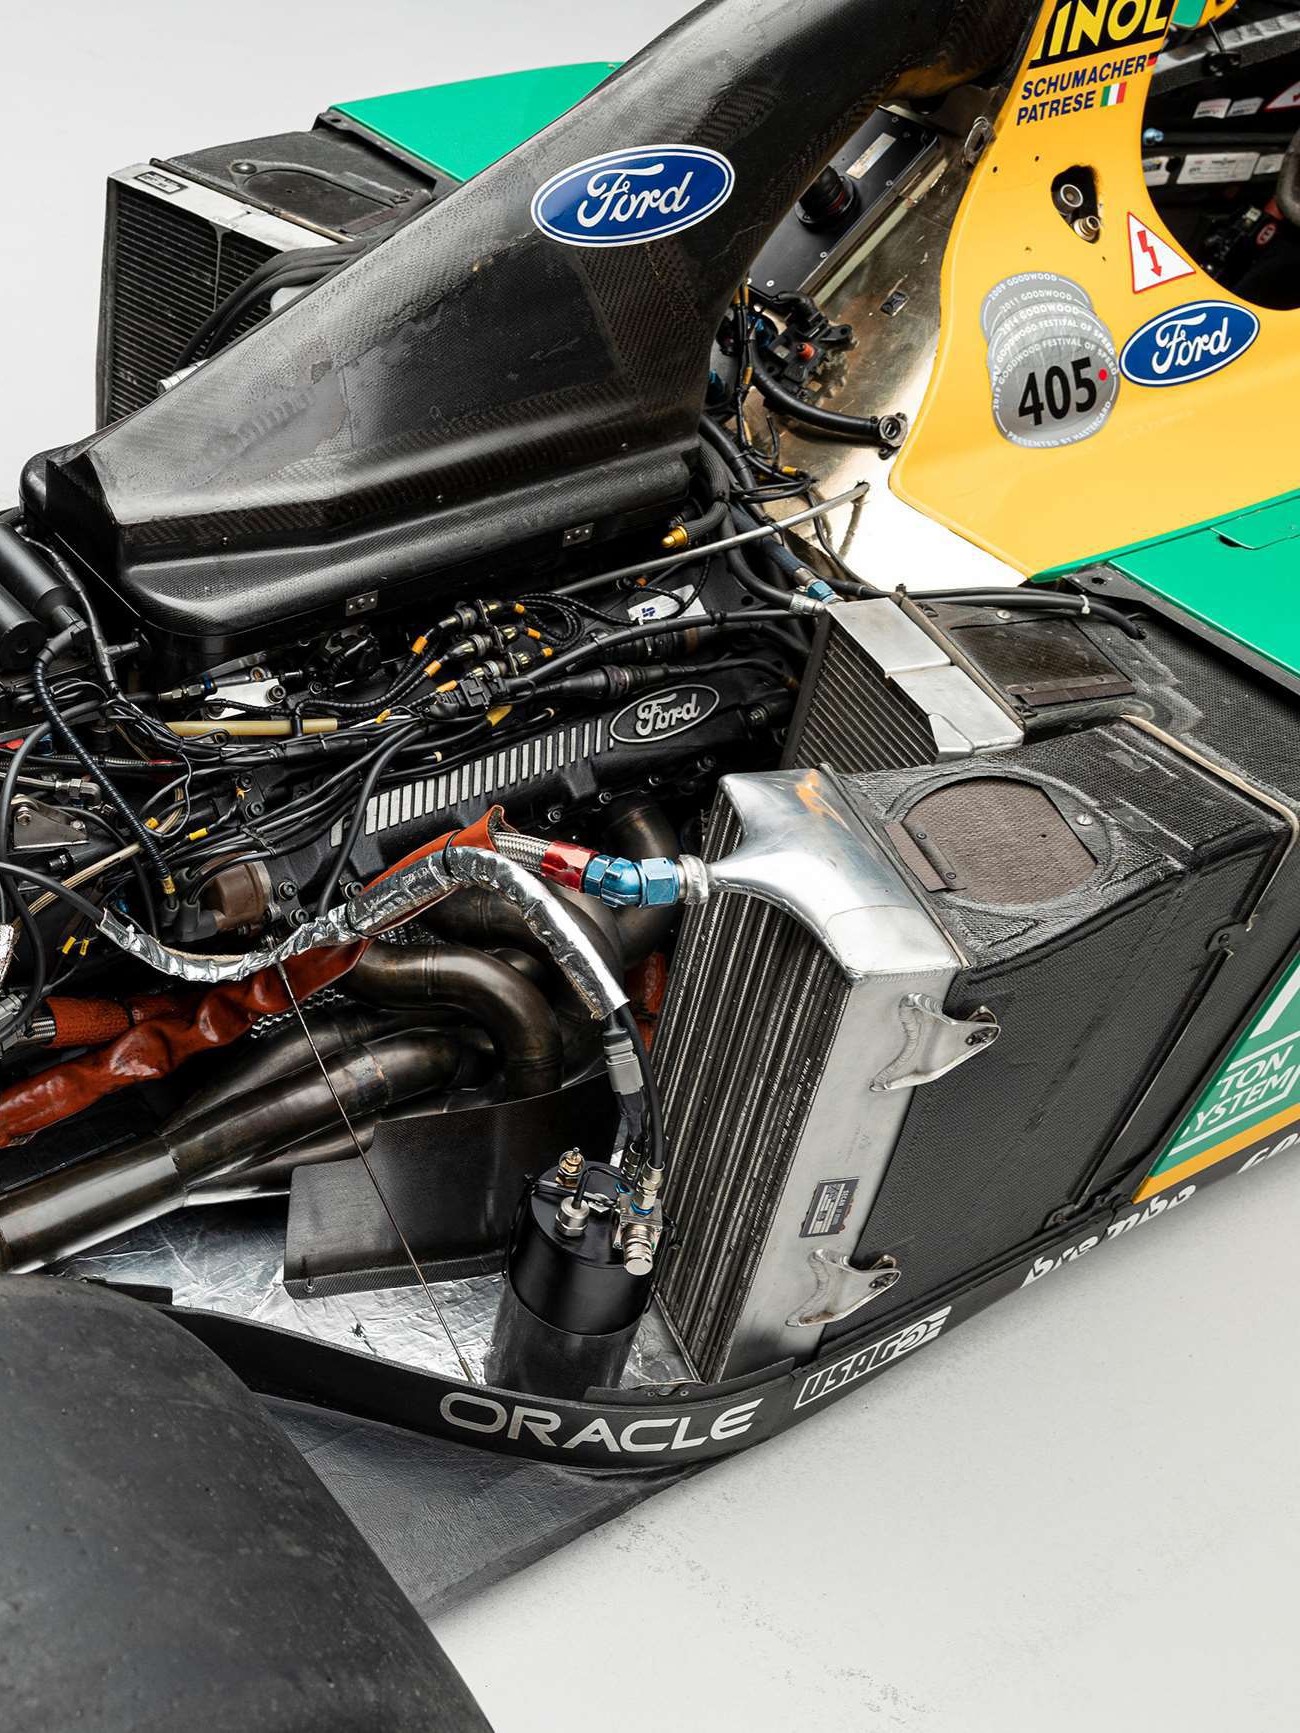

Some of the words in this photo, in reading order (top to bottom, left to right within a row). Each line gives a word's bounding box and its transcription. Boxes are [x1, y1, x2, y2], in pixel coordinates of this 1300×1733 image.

[1033, 0, 1168, 60] INOL
[1021, 54, 1147, 100] SCHUMACHER
[1016, 90, 1096, 126] PATRESE
[576, 163, 694, 228] Ford
[1006, 272, 1058, 287] GOODWOOD
[1020, 289, 1073, 301] GOODWOOD
[1019, 303, 1081, 318] GOODWOOD
[1039, 318, 1079, 329] FESTIVAL
[1081, 322, 1093, 331] OF
[1094, 330, 1115, 356] SPEED
[1151, 312, 1232, 375] Ford
[999, 342, 1042, 386] GOODWOOD
[1042, 337, 1083, 349] FESTIVAL
[1084, 341, 1097, 352] OF
[1097, 348, 1117, 376] SPEED
[1018, 356, 1098, 427] 405
[1072, 400, 1112, 441] MASTERCARD
[635, 692, 701, 737] Ford
[1180, 1064, 1297, 1138] YSTEM
[440, 1387, 765, 1453] ORACLE
